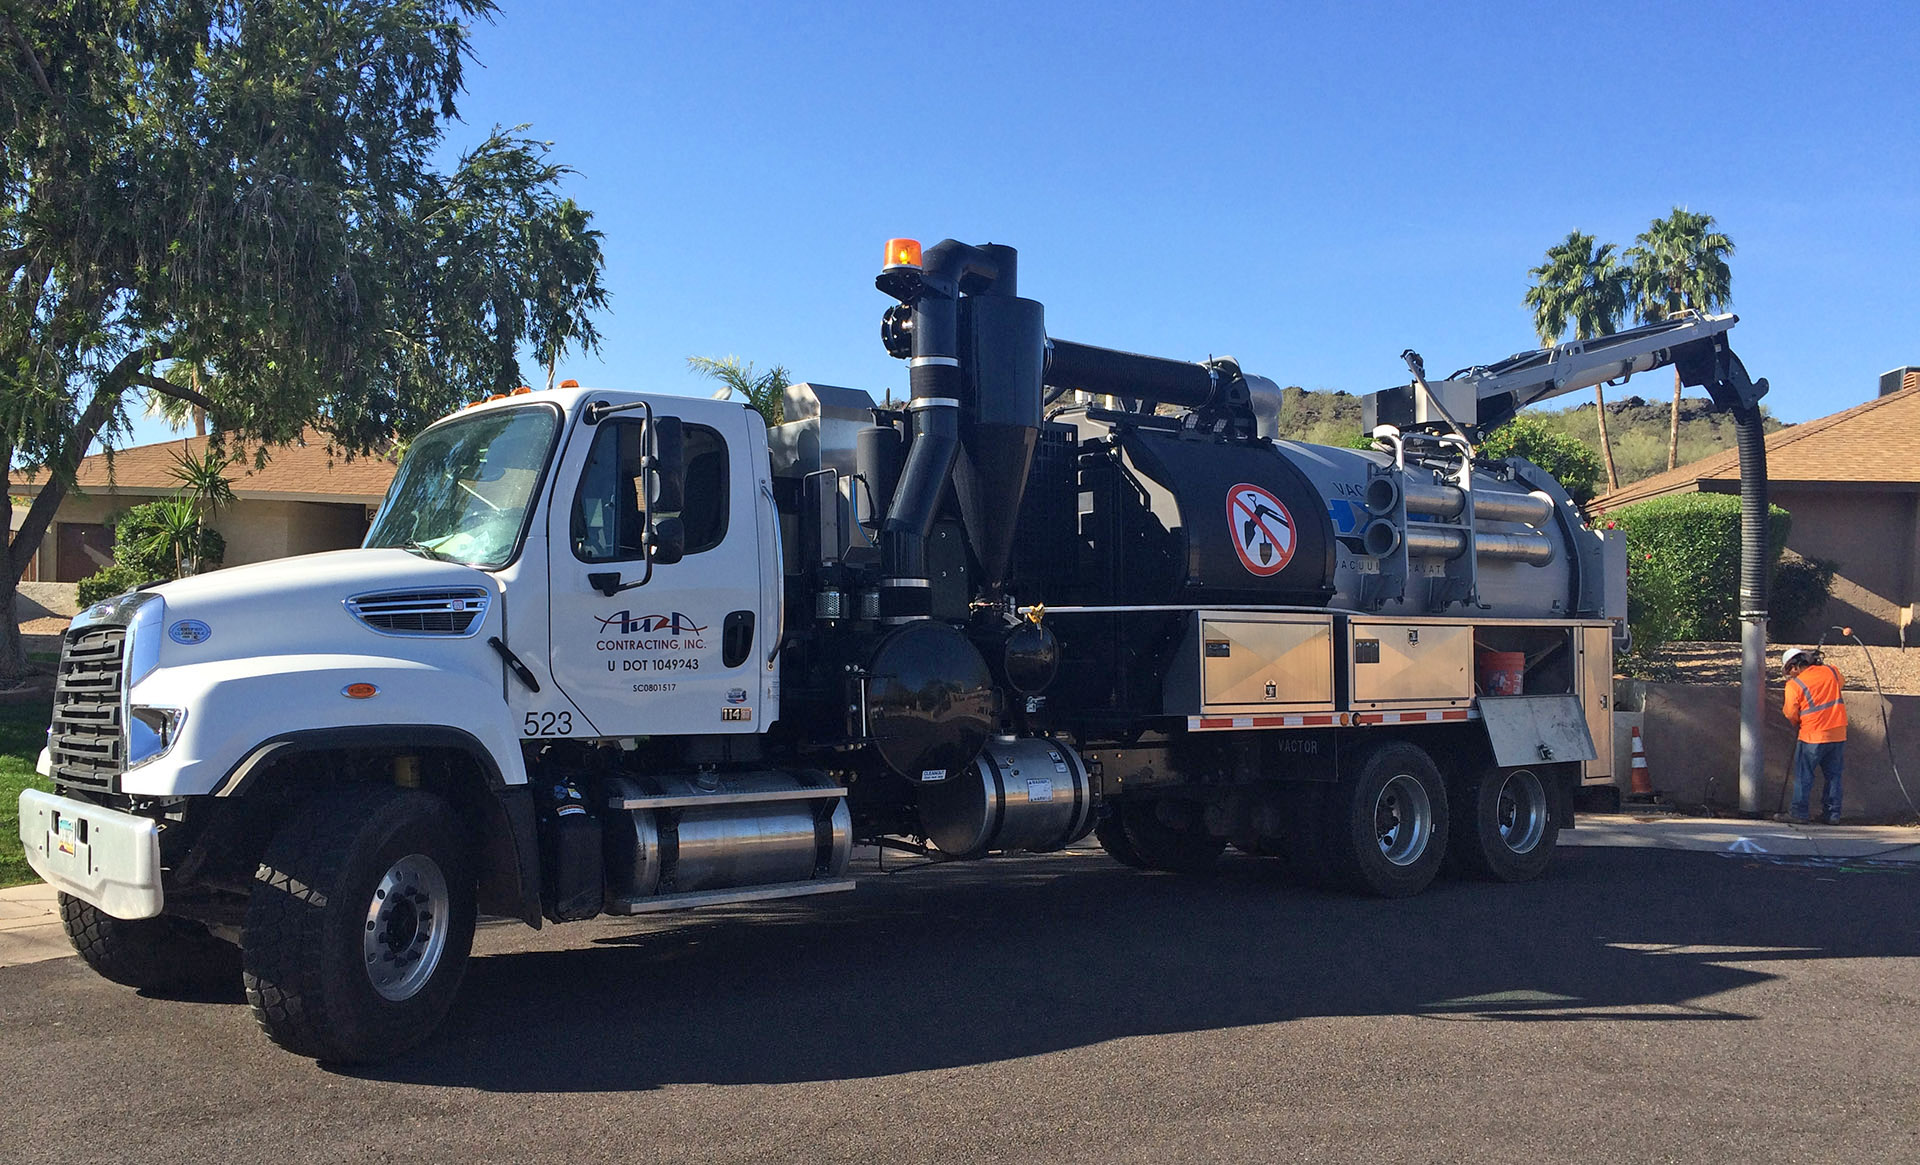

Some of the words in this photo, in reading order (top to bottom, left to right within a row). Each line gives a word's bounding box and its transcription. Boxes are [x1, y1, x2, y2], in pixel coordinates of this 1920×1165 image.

[1332, 482, 1364, 496] VAC
[596, 639, 680, 651] CONTRACTING,
[684, 639, 707, 650] INC.
[623, 659, 648, 671] DOT
[633, 683, 676, 693] SC0801517
[722, 709, 740, 720] 114
[523, 711, 573, 736] 523
[1278, 739, 1318, 755] VACTOR
